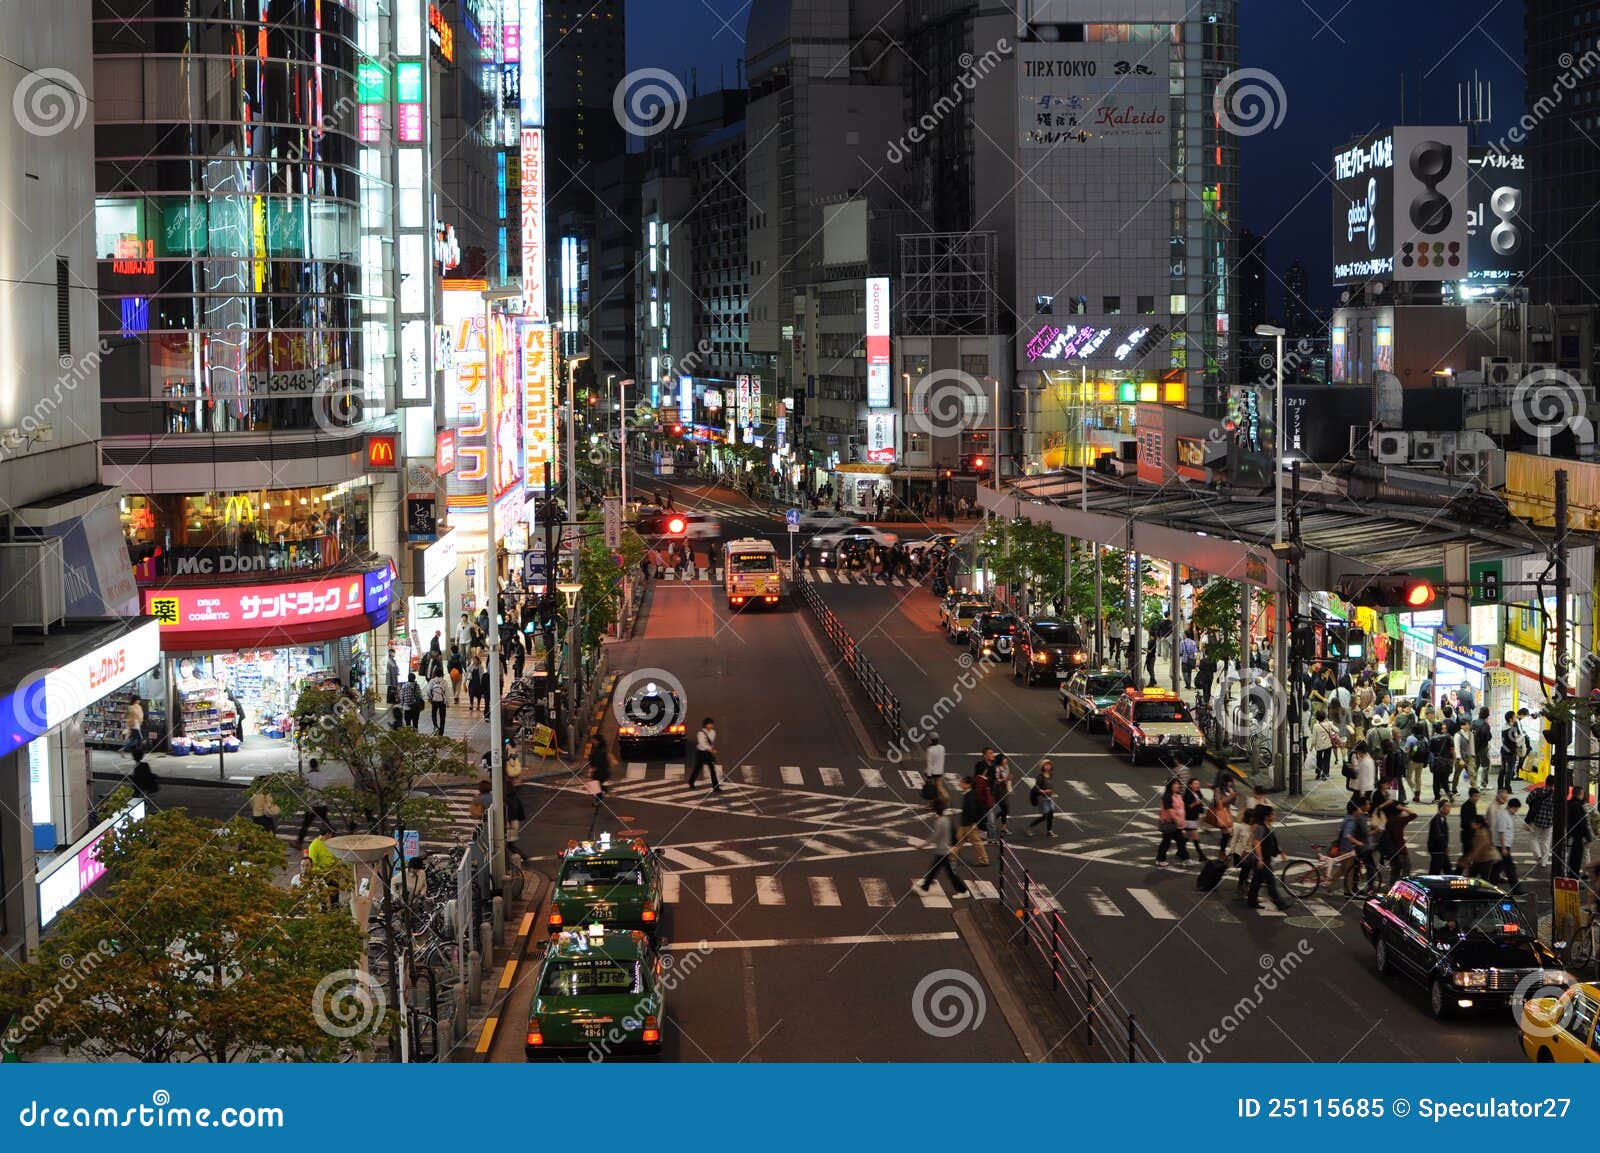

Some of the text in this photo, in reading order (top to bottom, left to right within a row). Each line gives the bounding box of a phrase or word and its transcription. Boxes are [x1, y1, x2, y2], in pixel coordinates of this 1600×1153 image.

[1056, 60, 1097, 77] TOKYO
[1094, 105, 1165, 128] Kaleido
[1348, 198, 1368, 242] global
[455, 315, 488, 481] パチンコ
[177, 557, 213, 575] Mc
[154, 599, 176, 623] 薬
[197, 598, 220, 608] DRUG
[240, 587, 341, 620] サンドラッグ
[188, 611, 230, 621] COSMETIC
[90, 648, 125, 689] ビックカメラ
